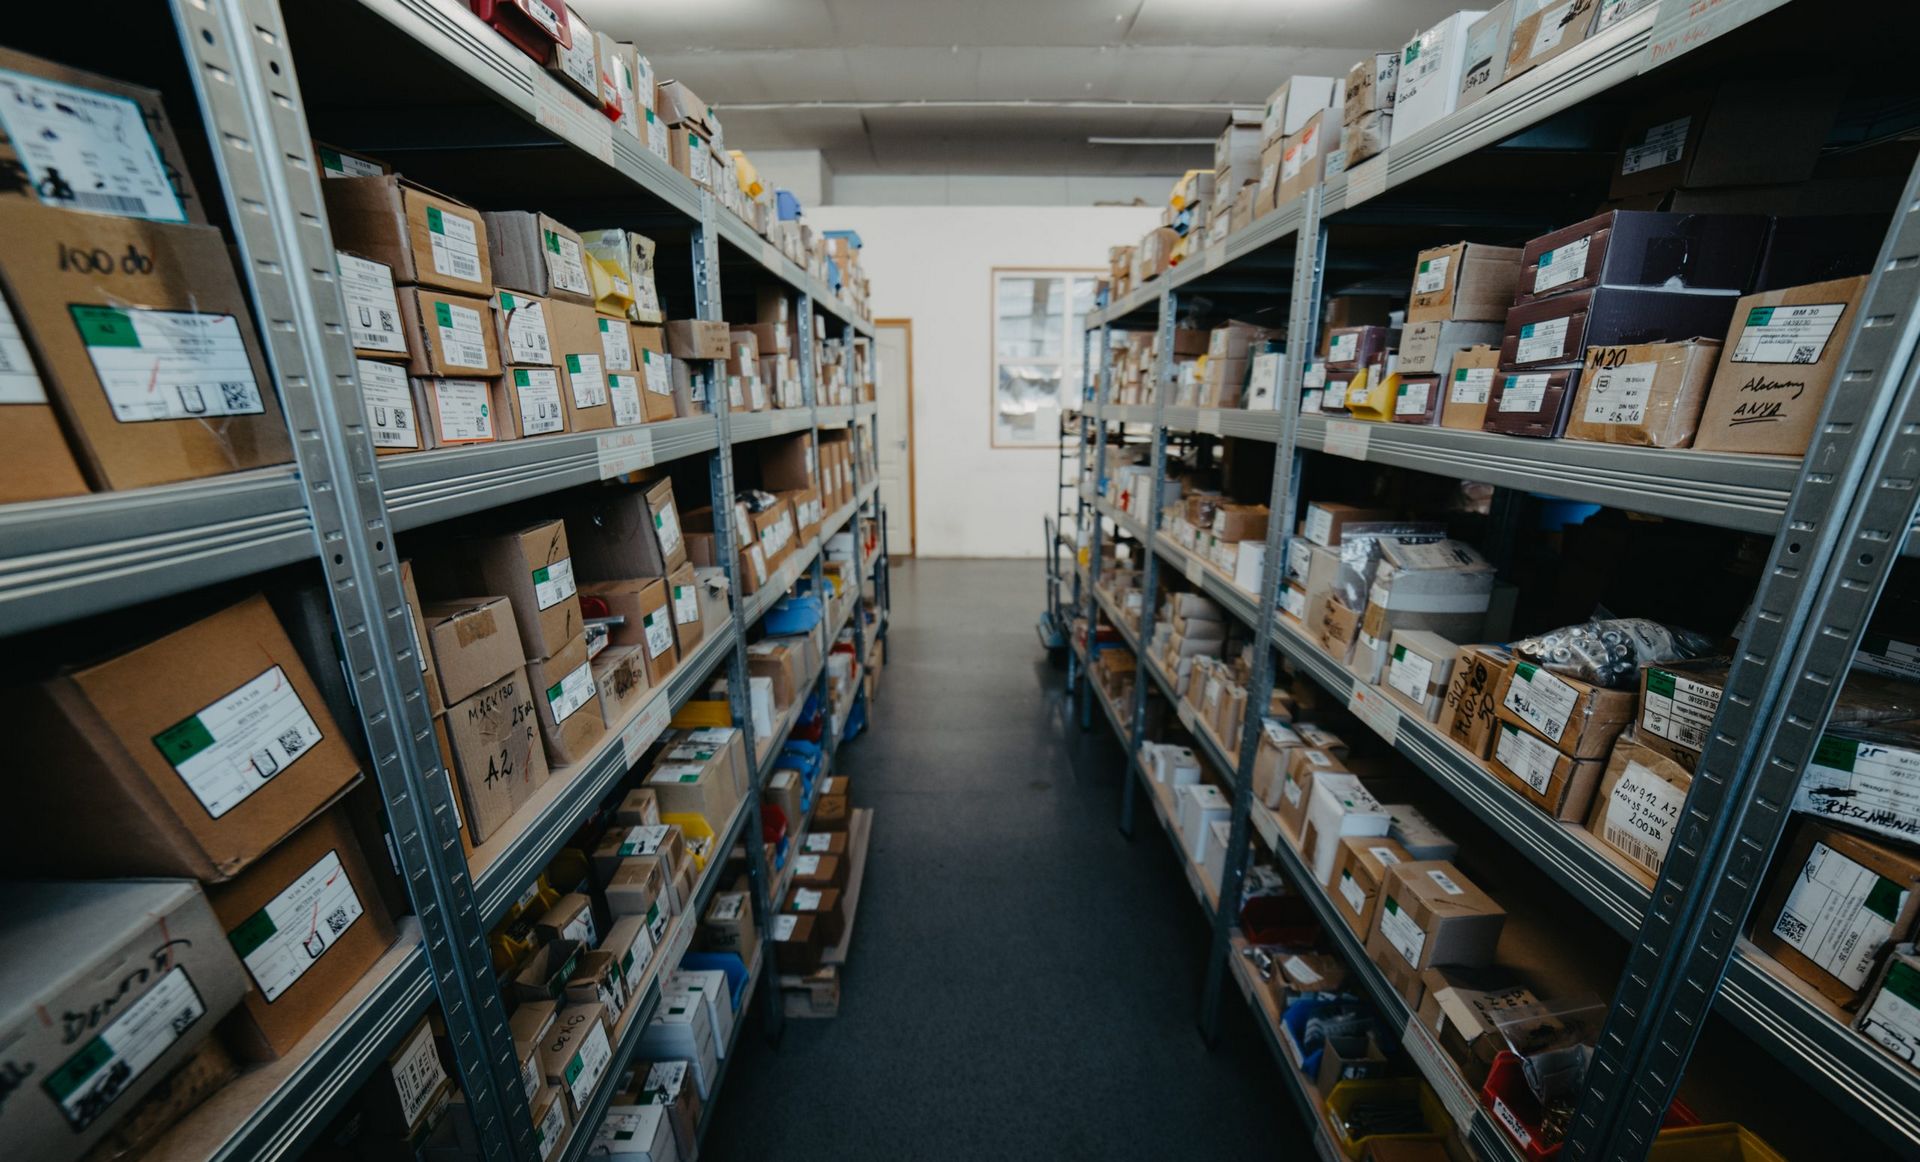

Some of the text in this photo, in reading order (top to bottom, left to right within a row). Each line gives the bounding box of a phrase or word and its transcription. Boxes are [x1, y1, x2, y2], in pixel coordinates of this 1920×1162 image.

[57, 241, 115, 275] 100
[1591, 347, 1628, 371] M20
[1733, 401, 1783, 418] ANYA
[1696, 686, 1704, 694] 10
[1710, 691, 1719, 699] 35
[484, 749, 513, 791] A2
[1622, 778, 1679, 819] DIN 912 A2
